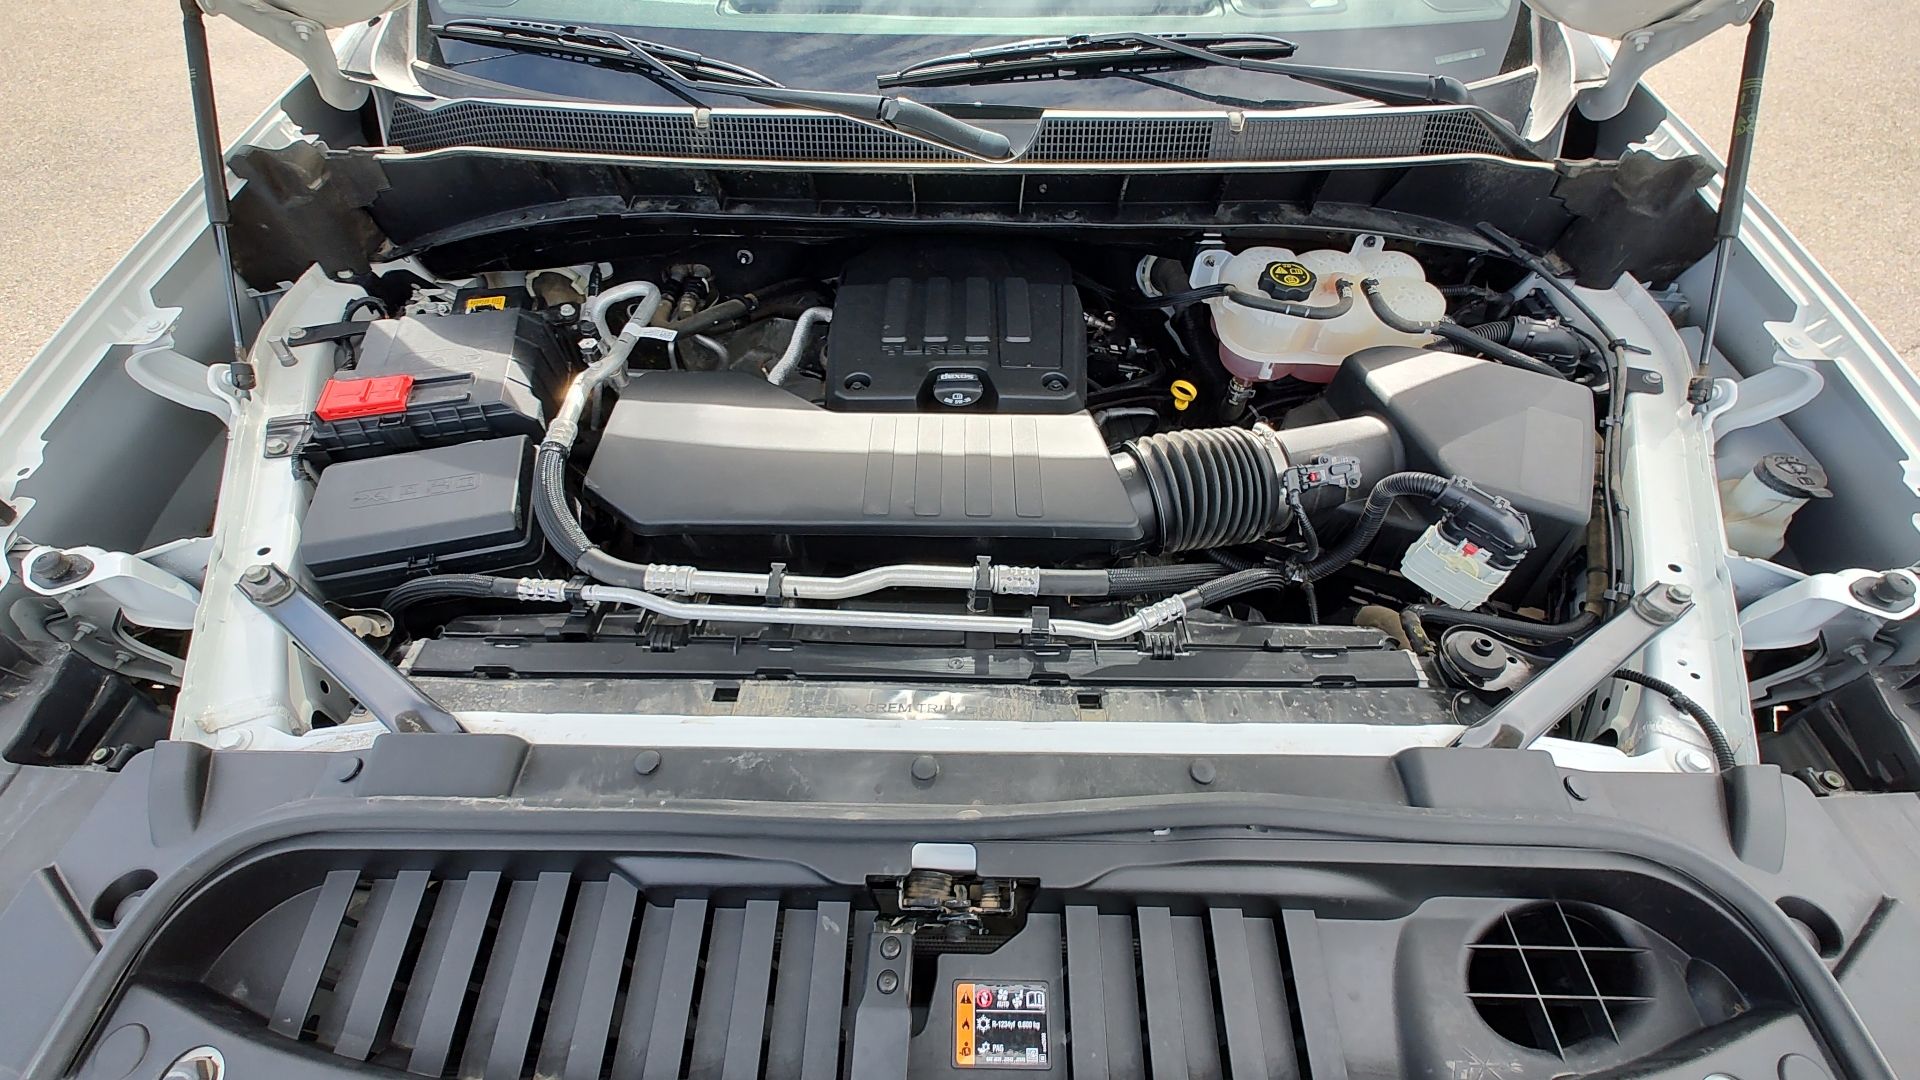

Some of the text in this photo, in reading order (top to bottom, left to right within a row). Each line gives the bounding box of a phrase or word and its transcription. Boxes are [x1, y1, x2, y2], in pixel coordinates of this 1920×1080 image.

[881, 344, 989, 355] TURBO
[996, 1000, 1010, 1009] AUTO
[1033, 1020, 1041, 1031] kg
[992, 1043, 1004, 1052] PAG
